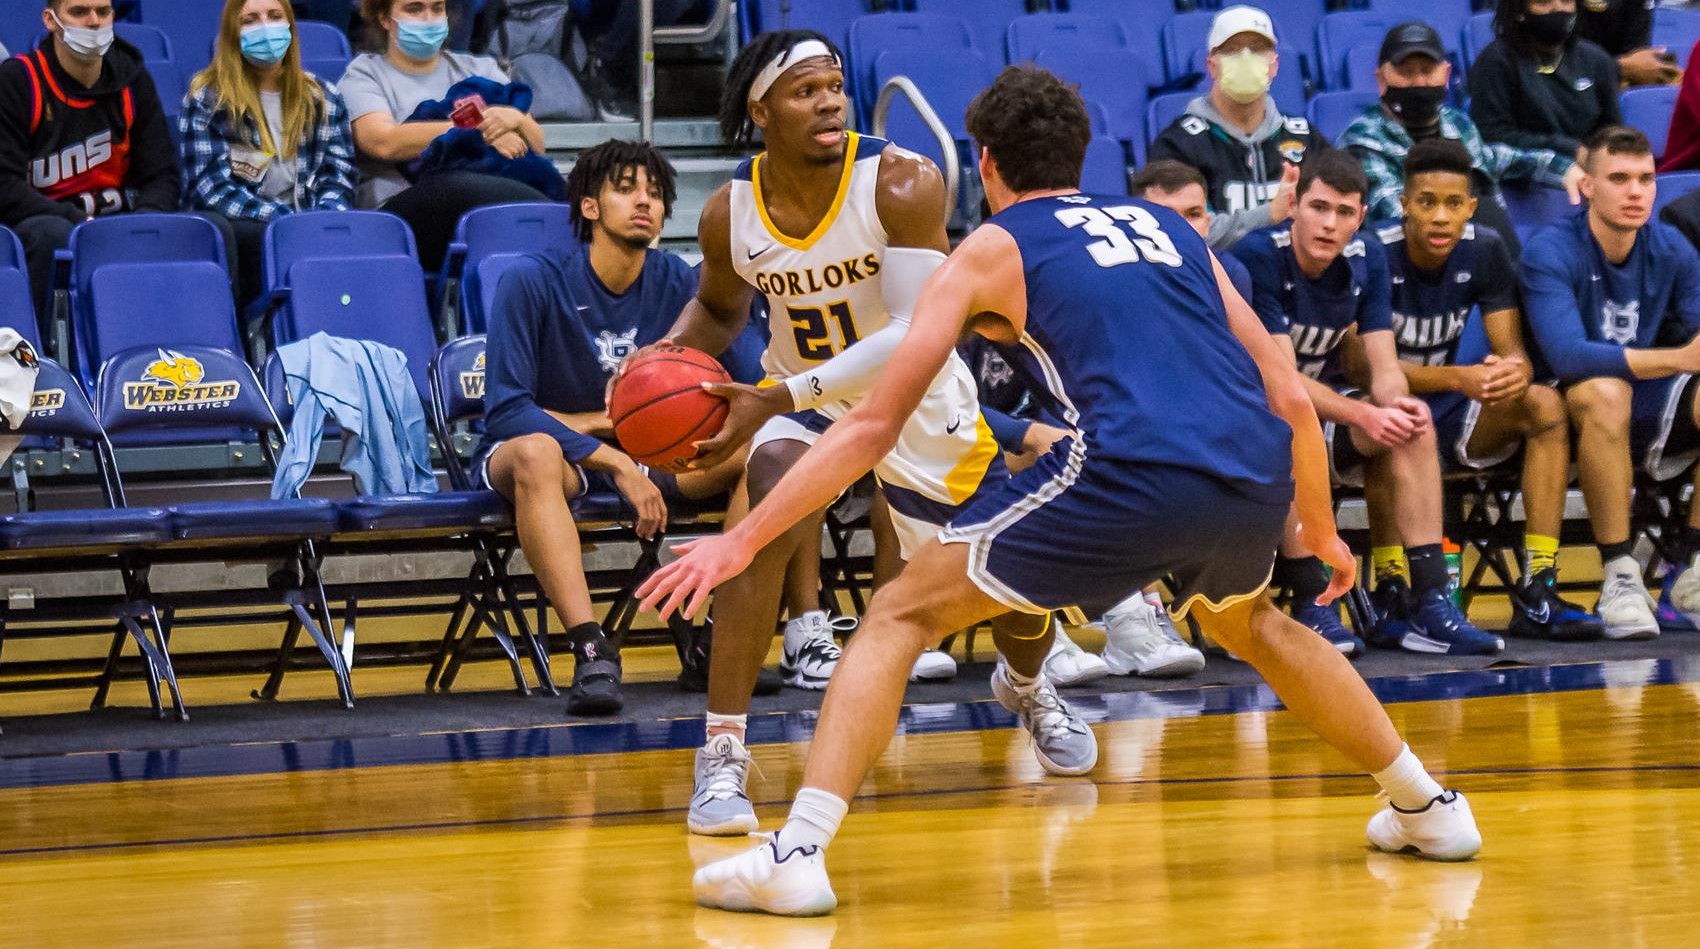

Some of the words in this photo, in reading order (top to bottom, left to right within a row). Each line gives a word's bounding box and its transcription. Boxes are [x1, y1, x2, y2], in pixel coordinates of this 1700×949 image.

[29, 129, 112, 188] UNS
[1054, 205, 1183, 268] 33
[755, 253, 880, 296] GORLOKS
[786, 299, 863, 365] 21
[124, 383, 238, 407] WEBSTER
[148, 400, 231, 413] ATHLETICS
